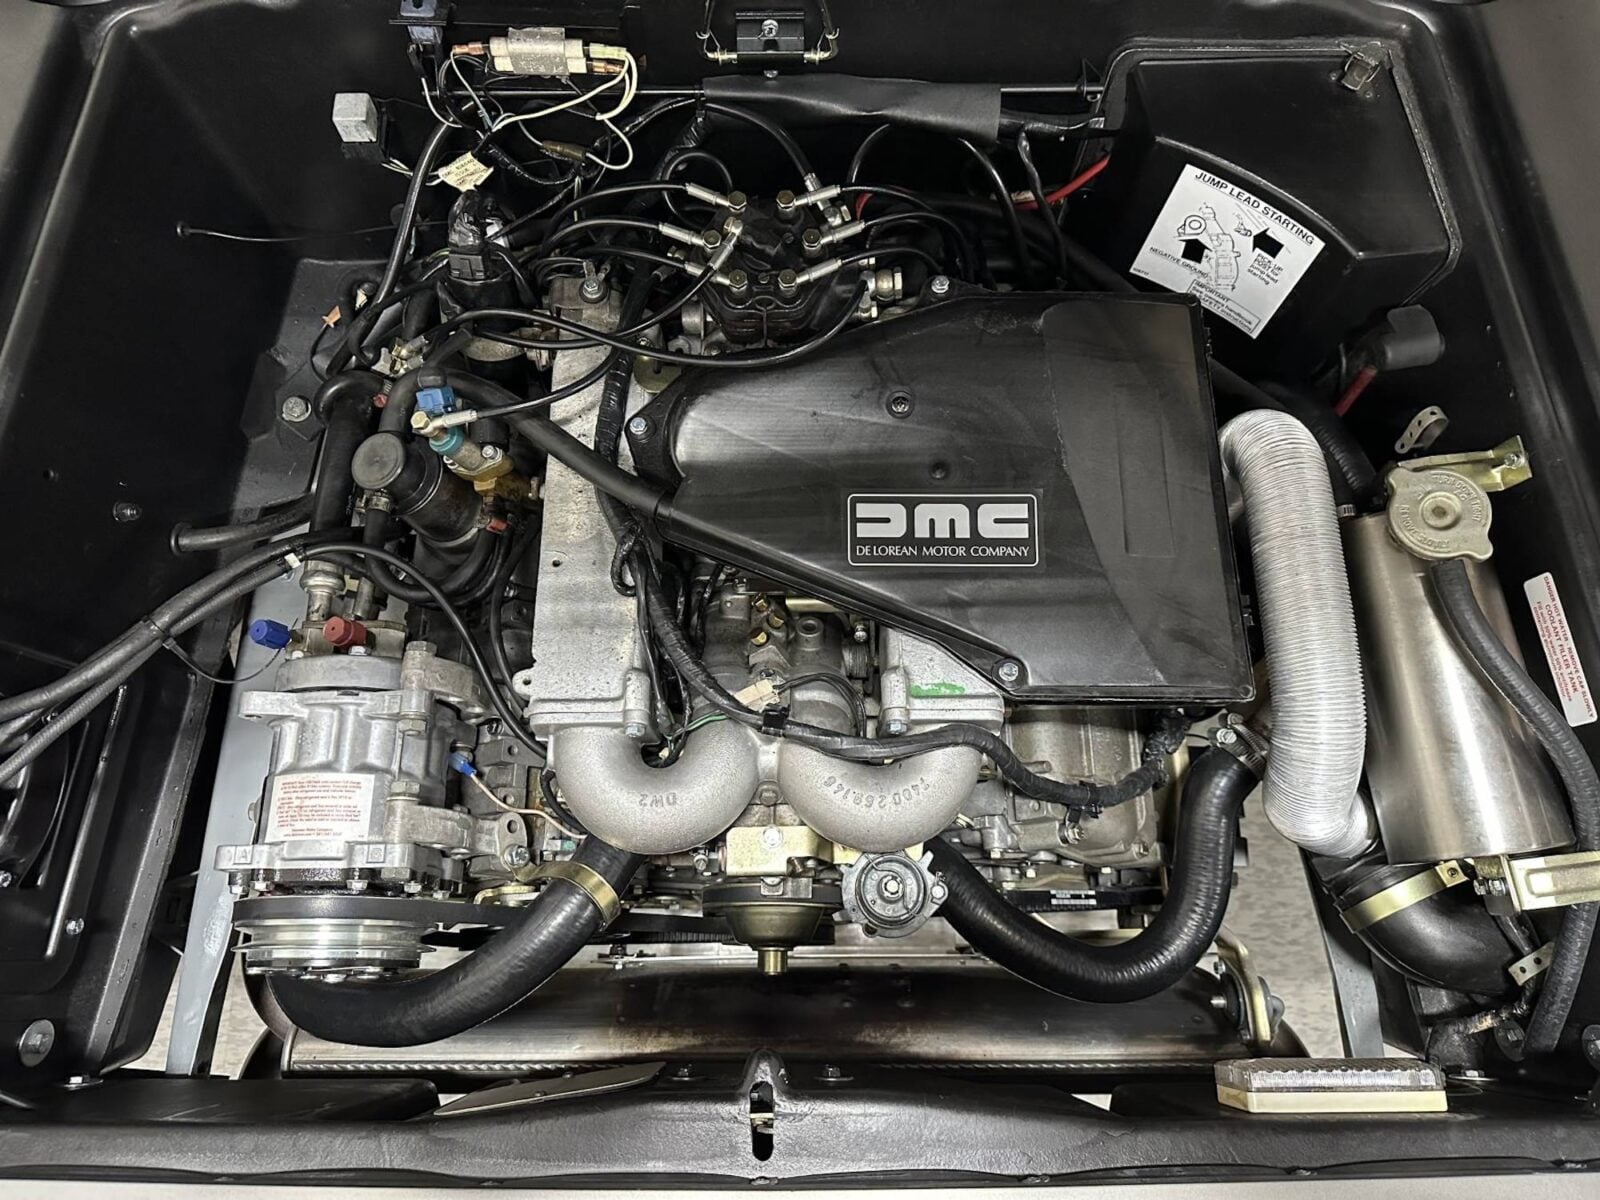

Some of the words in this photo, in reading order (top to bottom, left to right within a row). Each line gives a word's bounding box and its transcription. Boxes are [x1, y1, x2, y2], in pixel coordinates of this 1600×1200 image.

[1195, 172, 1228, 191] JUMP
[1229, 187, 1260, 210] LEAD
[1261, 206, 1316, 246] STARTING
[1150, 246, 1180, 264] NEGATIVE
[1182, 261, 1209, 278] GROUND
[1253, 258, 1271, 271] POST
[1247, 268, 1270, 285] starting
[1195, 282, 1230, 303] IMPORTANT
[1225, 306, 1252, 325] handbook
[856, 503, 1029, 538] DMC
[856, 546, 871, 555] DE
[874, 546, 917, 556] LOREAN
[922, 546, 966, 556] MOTOR
[971, 546, 1029, 556] COMPANY
[1544, 576, 1556, 603] DANGER
[1552, 603, 1561, 617] HOT
[1558, 619, 1569, 642] WATER
[1567, 647, 1579, 674] REMOVE
[1576, 676, 1585, 689] CAP
[1581, 691, 1594, 718] SLOWLY
[1545, 604, 1562, 642] COOLANT
[1558, 644, 1571, 669] FILLER
[1567, 671, 1579, 693] TANK
